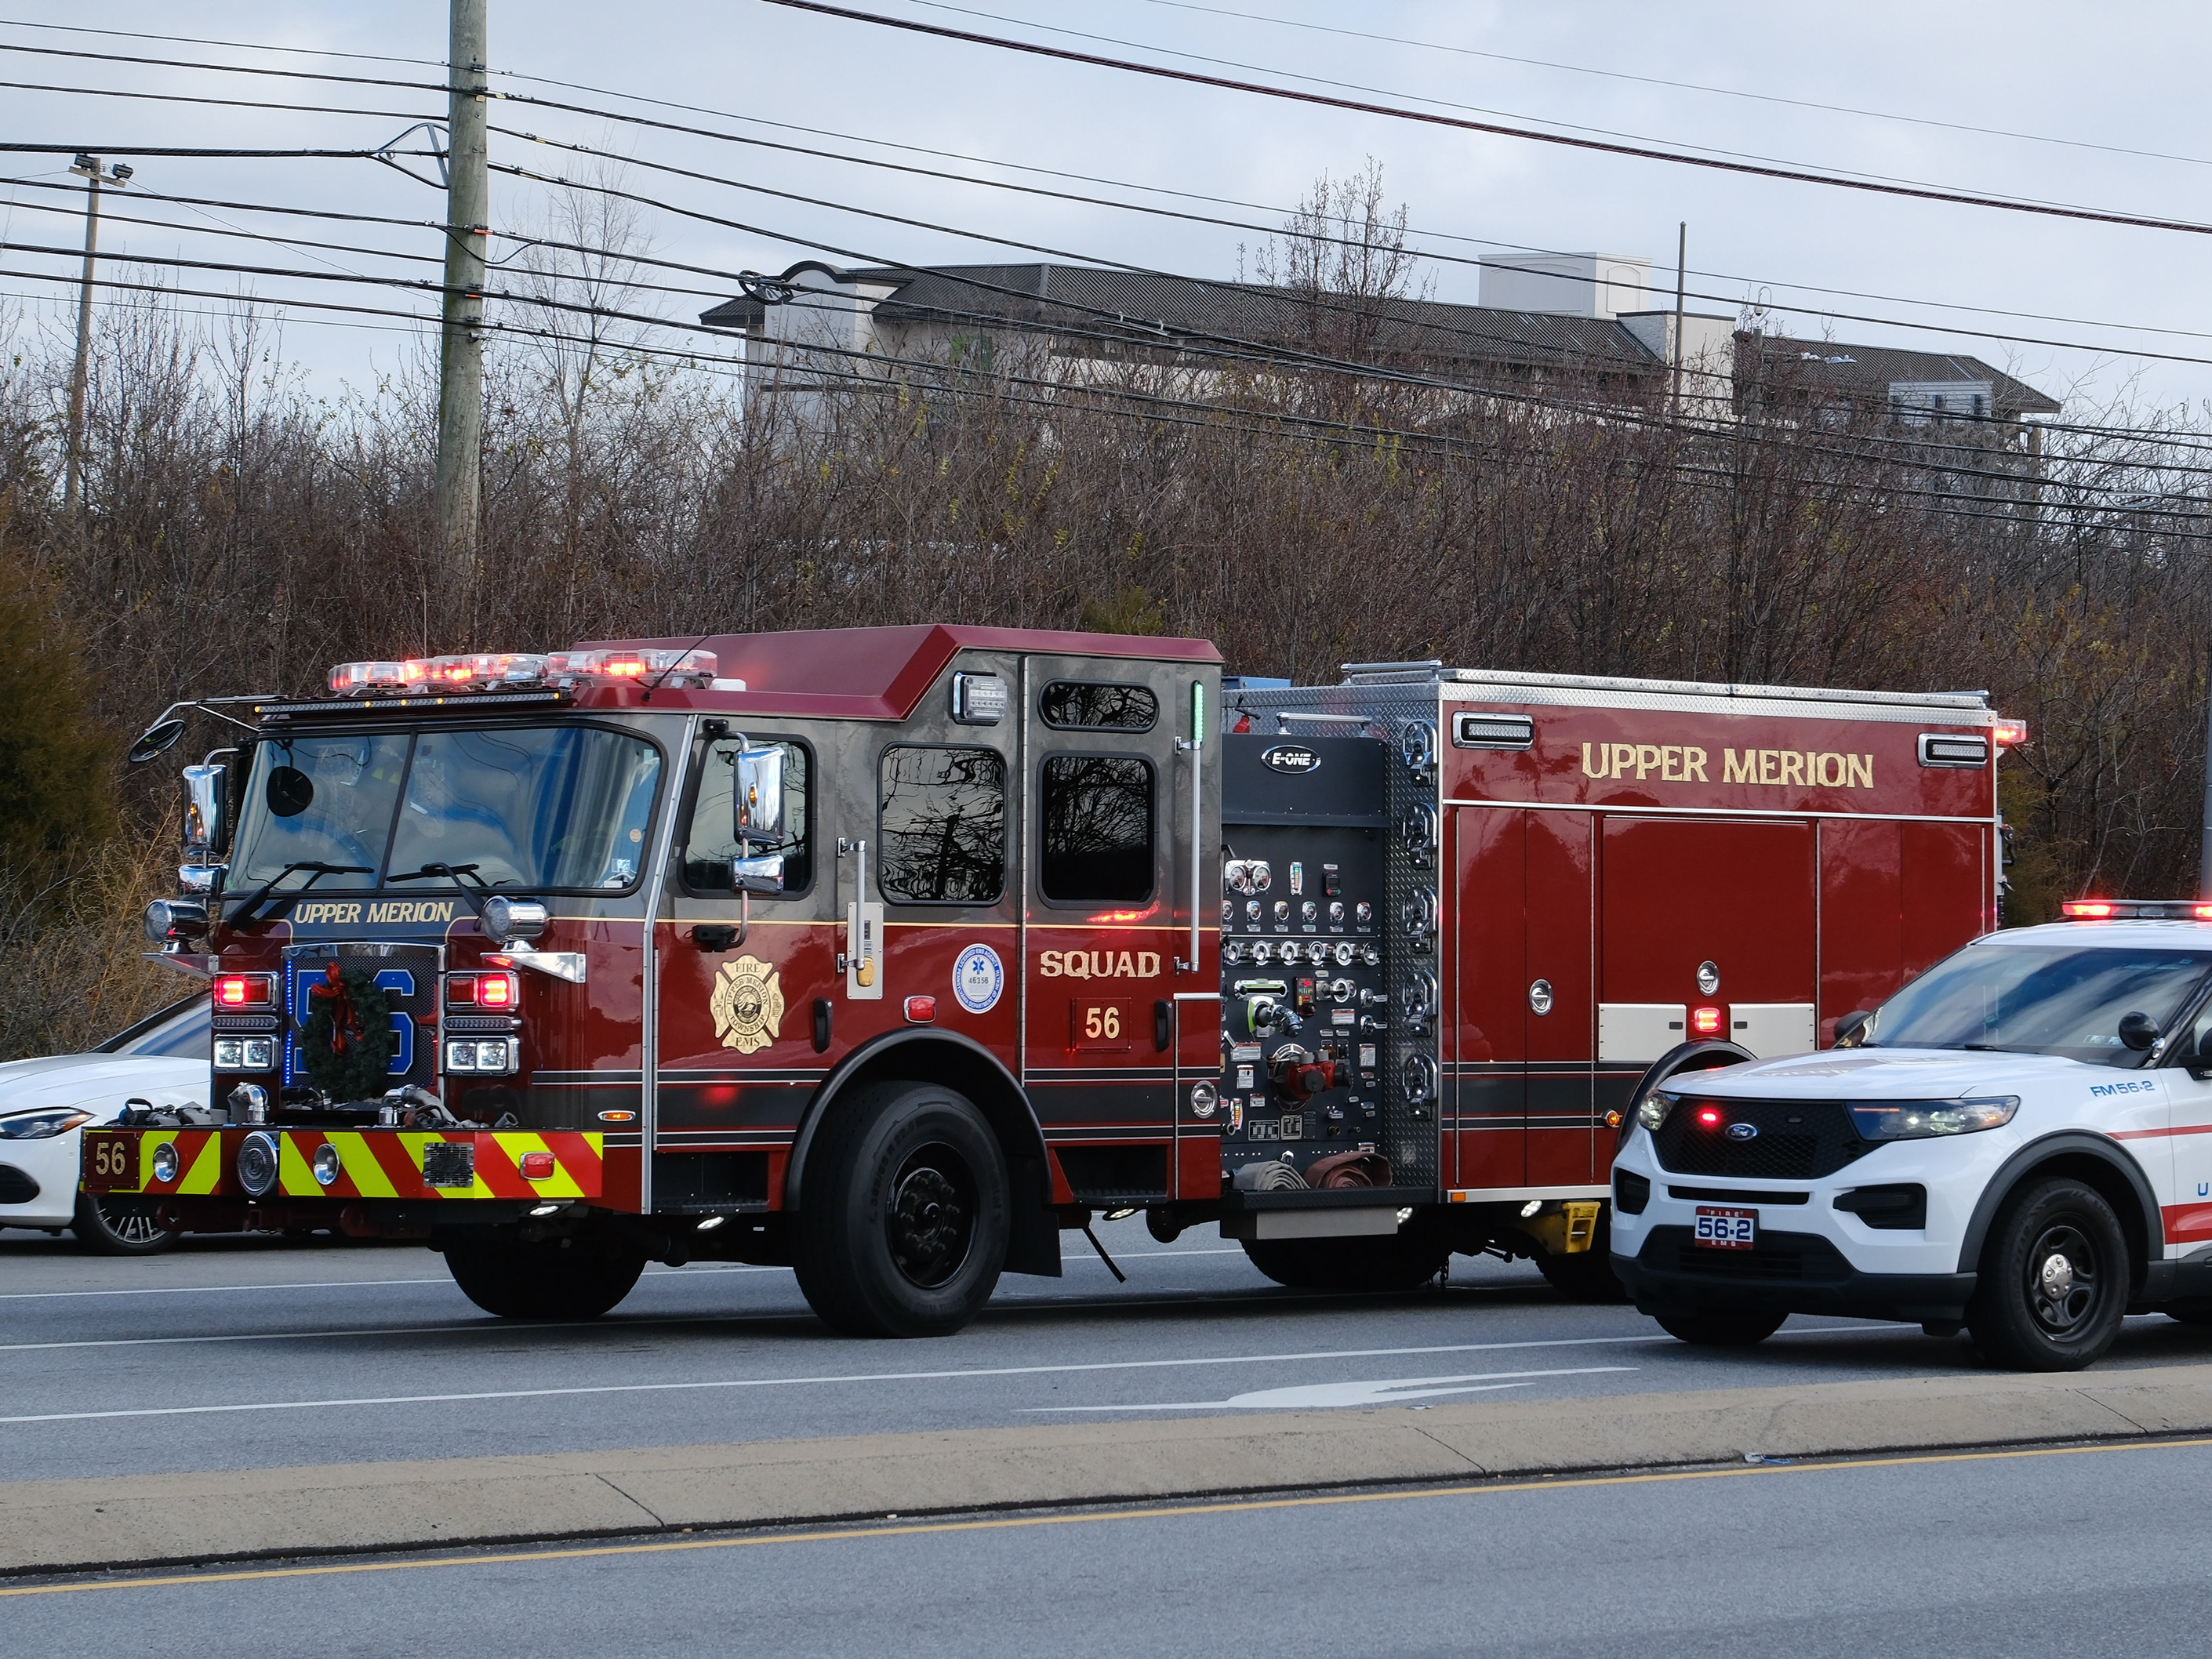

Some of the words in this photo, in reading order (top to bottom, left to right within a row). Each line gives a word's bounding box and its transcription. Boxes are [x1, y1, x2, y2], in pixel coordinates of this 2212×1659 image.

[1272, 752, 1312, 766] E-ONE
[1581, 742, 1709, 782] UPPER
[1722, 747, 1874, 789] MERION
[294, 902, 362, 924] UPPER
[366, 902, 455, 924] MERION
[736, 963, 761, 972] FIRE
[1040, 950, 1160, 980] SQUAD
[727, 978, 745, 1005] UPPER
[746, 977, 768, 1005] MERION
[730, 1014, 765, 1033] TOWNSHIP
[1085, 1007, 1120, 1039] 56
[736, 1037, 761, 1047] EMS
[95, 1142, 125, 1175] 56
[2197, 1182, 2209, 1197] U
[1698, 1217, 1750, 1240] 56-2
